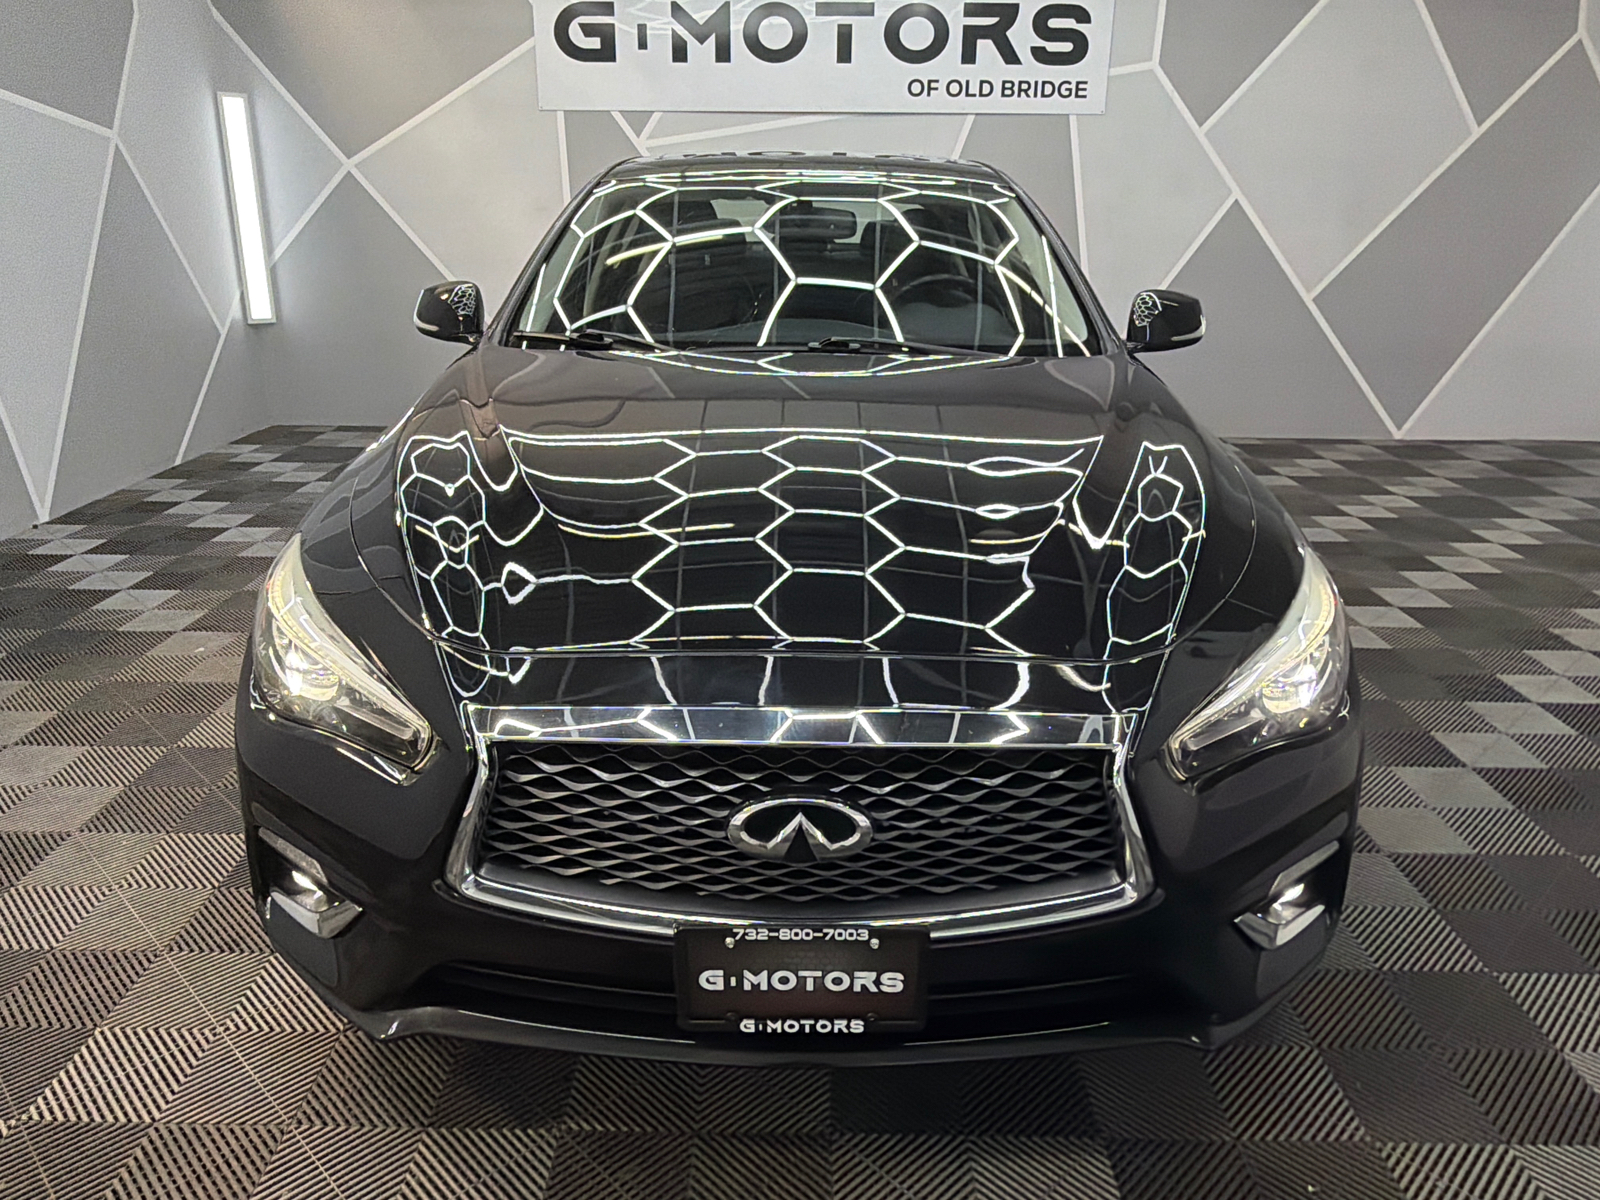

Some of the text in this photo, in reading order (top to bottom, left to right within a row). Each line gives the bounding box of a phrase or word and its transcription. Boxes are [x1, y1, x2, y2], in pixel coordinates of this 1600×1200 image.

[907, 79, 1089, 100] OF OLD BRIDGE
[733, 928, 870, 941] 732-800-7003
